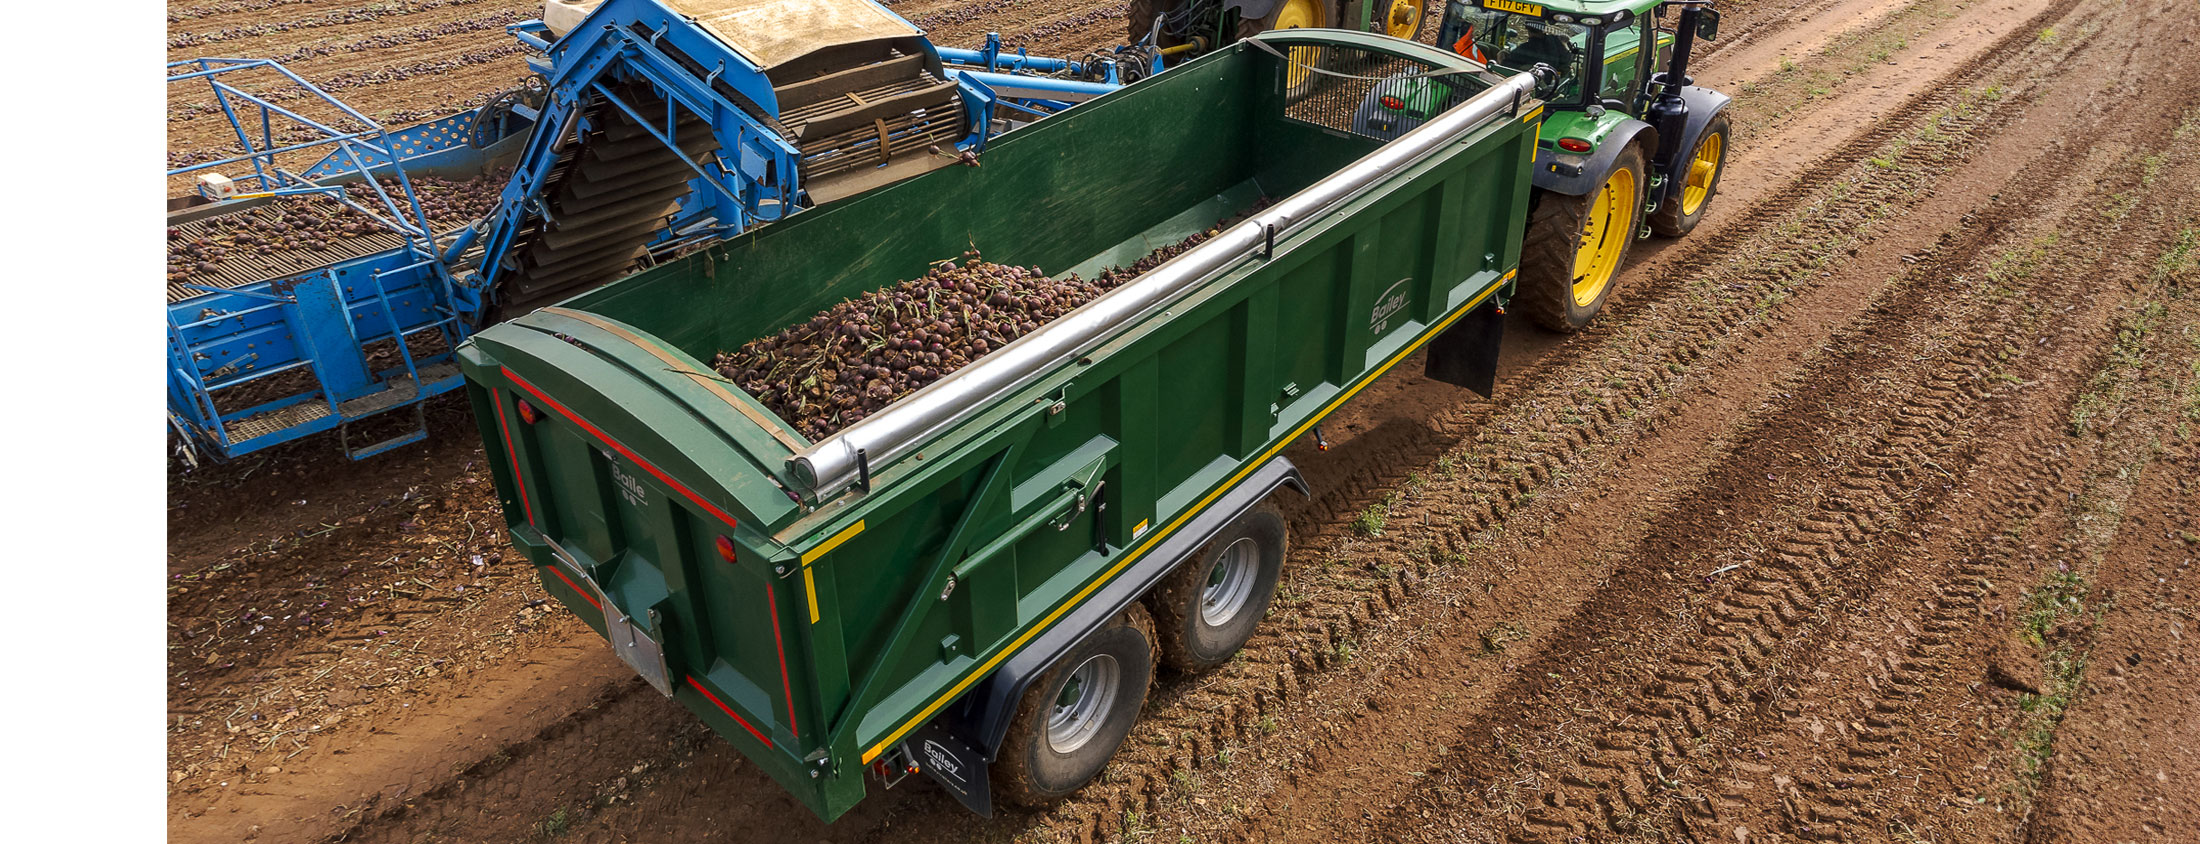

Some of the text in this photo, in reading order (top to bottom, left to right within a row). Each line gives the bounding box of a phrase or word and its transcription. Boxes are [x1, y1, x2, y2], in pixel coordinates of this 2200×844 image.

[1370, 290, 1407, 324] Bailey
[612, 463, 646, 499] Baile
[924, 741, 959, 774] Bailey
